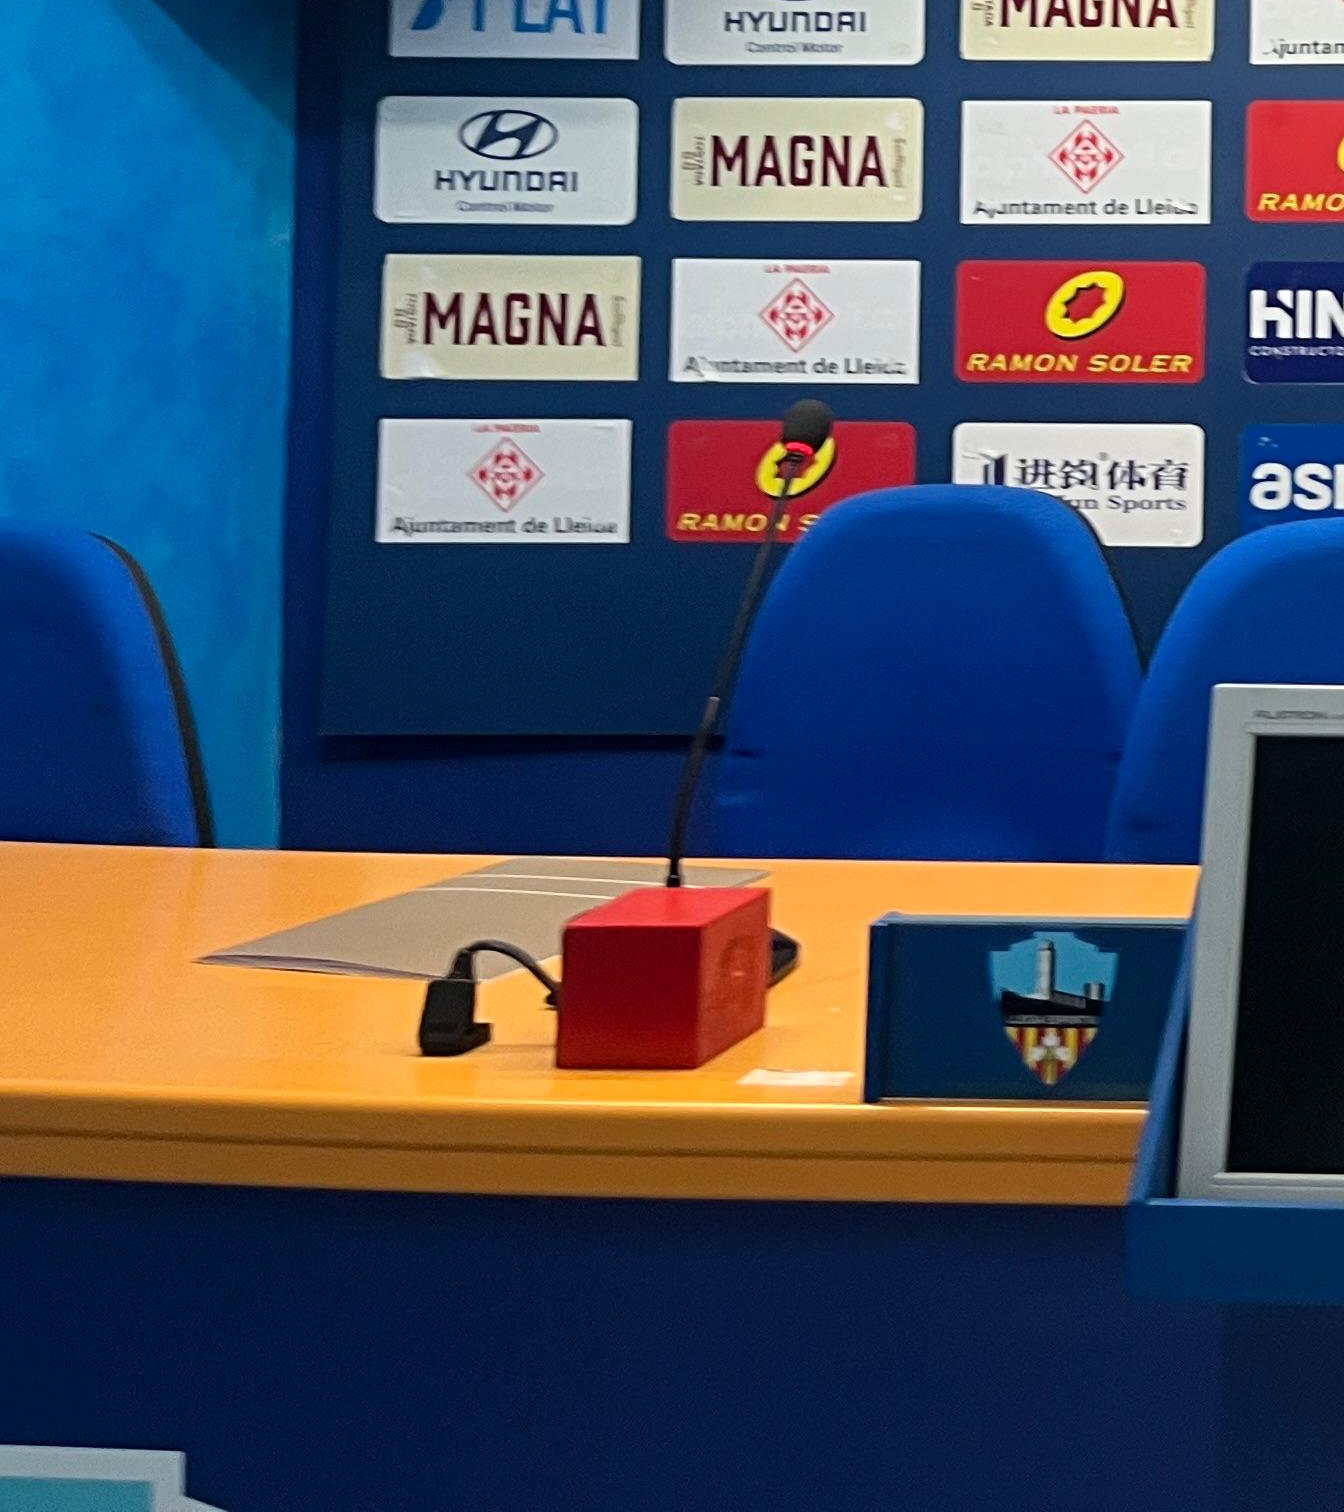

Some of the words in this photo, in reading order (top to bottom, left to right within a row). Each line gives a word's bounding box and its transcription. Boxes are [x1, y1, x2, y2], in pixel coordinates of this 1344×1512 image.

[725, 12, 865, 32] HYUNDAI
[711, 135, 887, 187] MAGNA
[435, 171, 577, 191] HYUNDAI
[1104, 199, 1128, 214] de
[424, 292, 606, 346] MAGNA
[813, 358, 838, 374] de
[967, 354, 1078, 371] RAMON
[1088, 355, 1192, 372] SOLER
[1108, 495, 1186, 513] Sports
[523, 518, 547, 533] de
